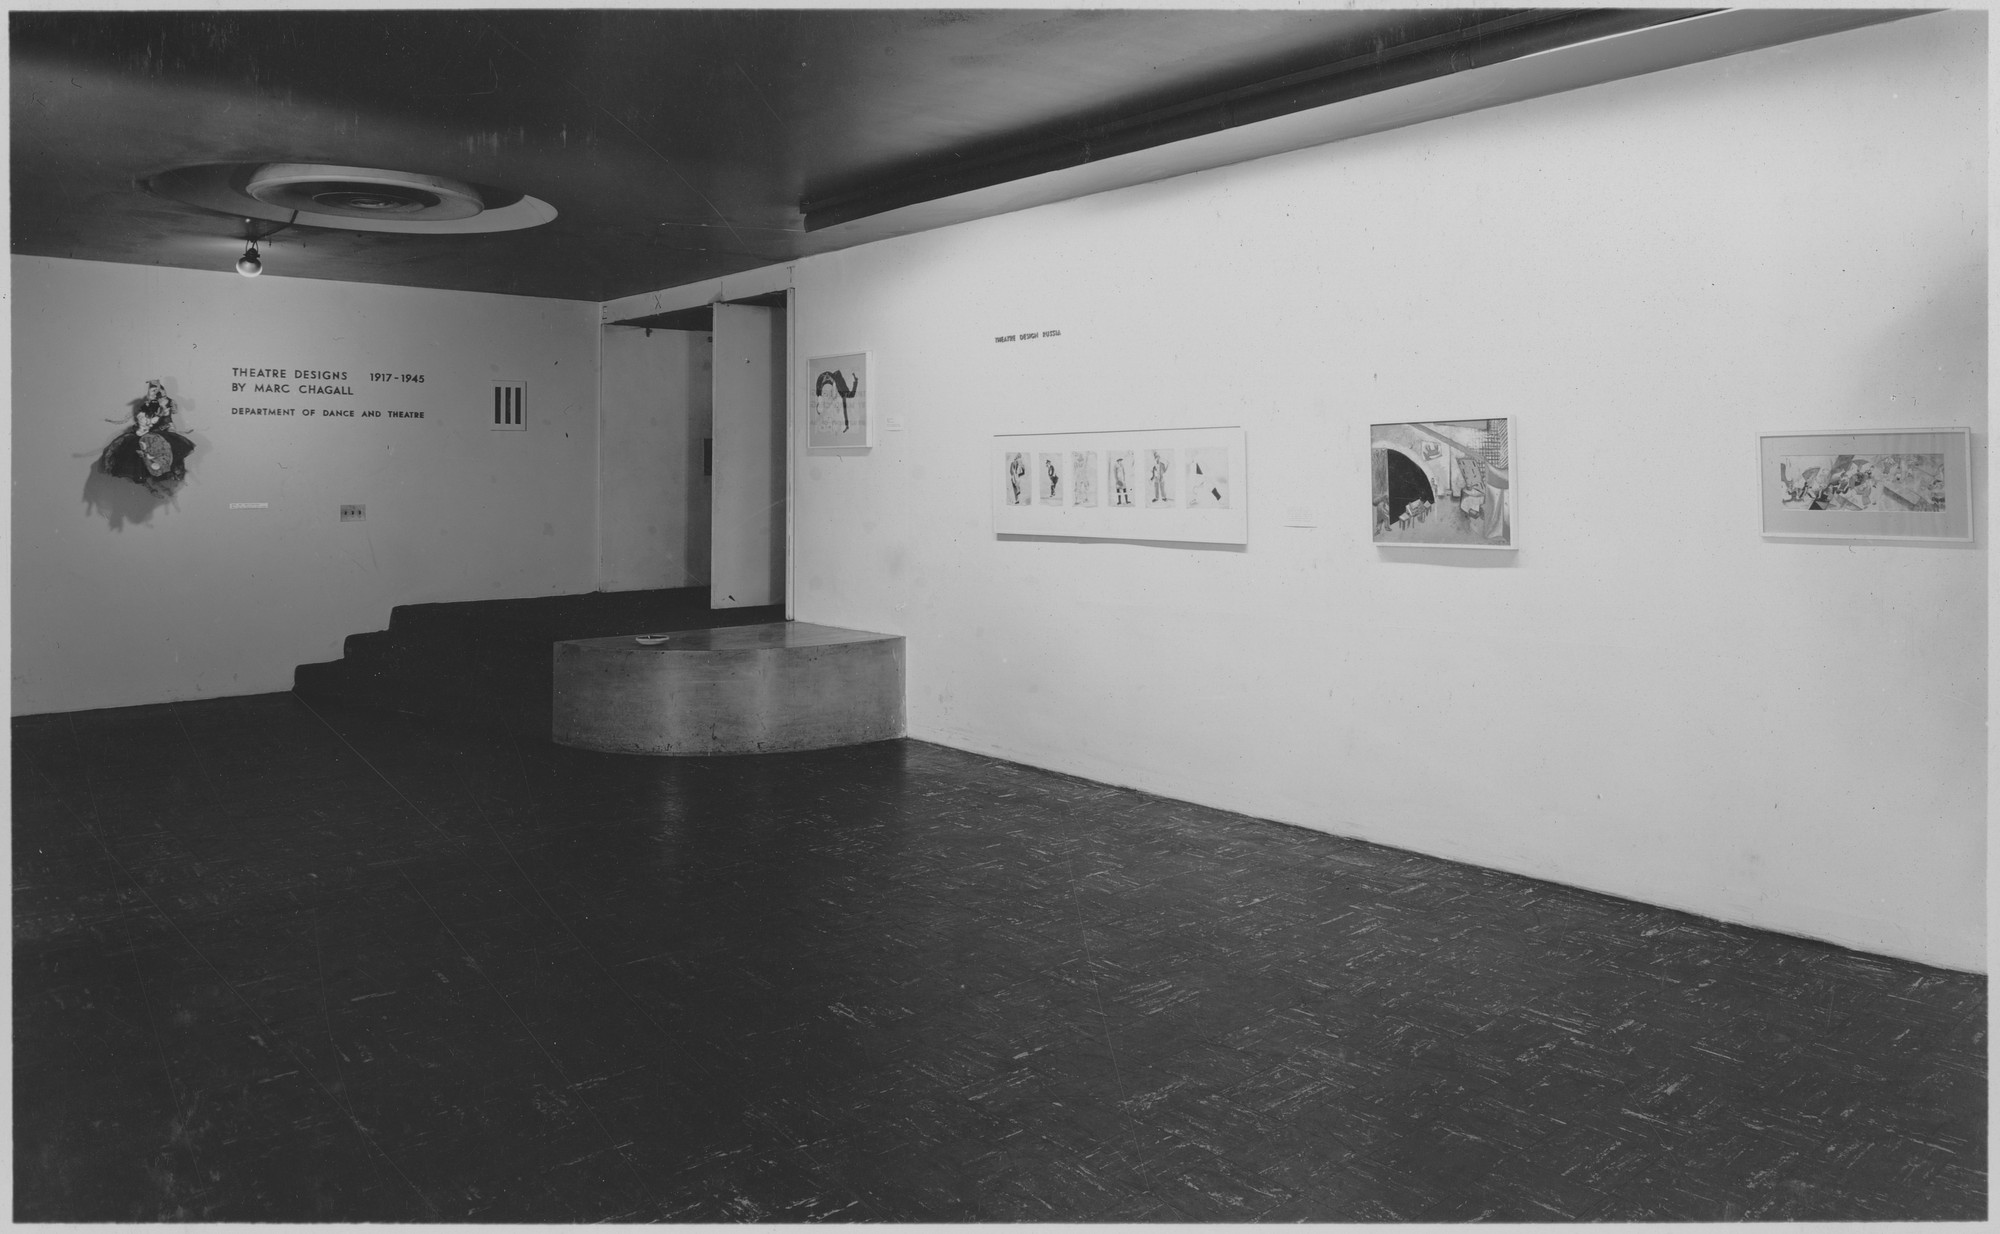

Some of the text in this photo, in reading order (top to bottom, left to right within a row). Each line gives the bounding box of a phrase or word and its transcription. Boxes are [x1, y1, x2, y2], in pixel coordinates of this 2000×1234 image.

[994, 329, 1061, 343] THEATRE DESIGN RUSSIA
[232, 368, 287, 379] THEATRE
[294, 370, 348, 381] DESIGNS
[231, 383, 354, 396] BY MARC CHAGALL
[231, 407, 425, 419] DEPARTMENT OF DANCE AND THEATRE
